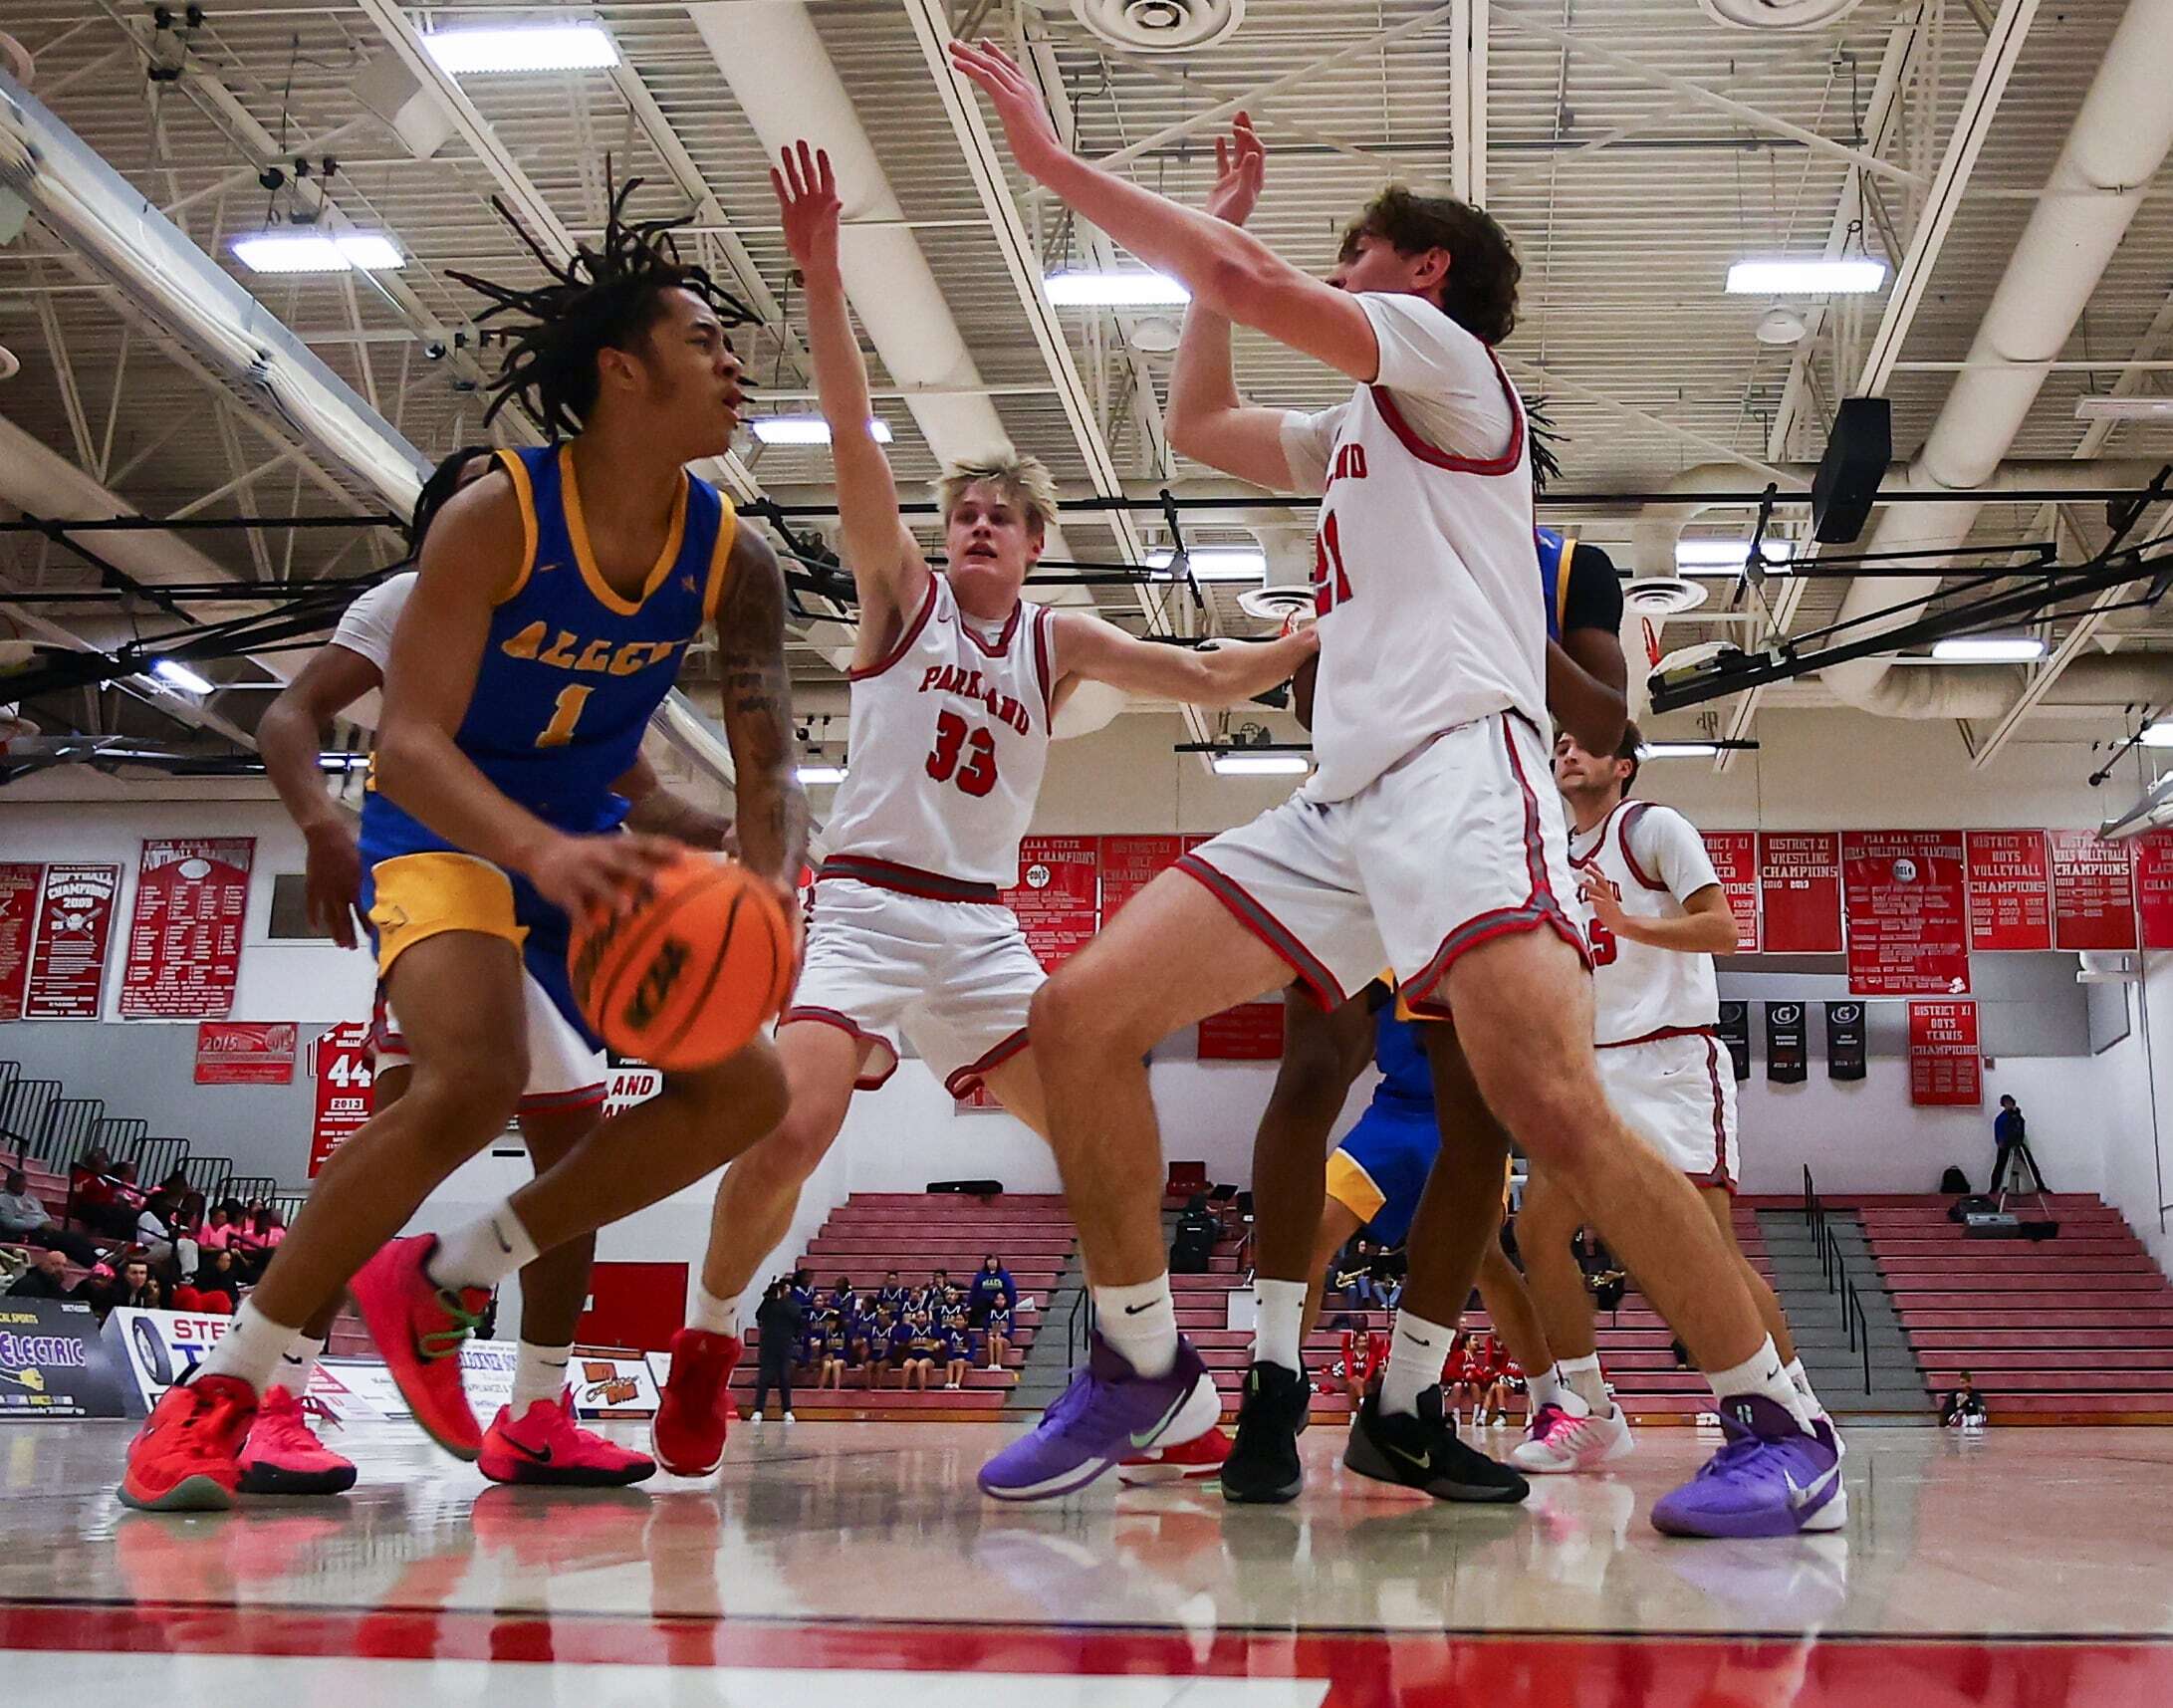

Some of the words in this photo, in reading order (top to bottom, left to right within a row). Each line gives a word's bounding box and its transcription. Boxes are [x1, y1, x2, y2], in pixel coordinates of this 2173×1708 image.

[535, 683, 596, 748] 1
[926, 709, 998, 797] 33
[1769, 839, 1814, 850] DISTRICT
[1770, 853, 1829, 864] WRESTLING
[1762, 865, 1838, 877] CHAMPIONS
[1973, 863, 2042, 876] VOLLEYBALL
[2053, 862, 2130, 876] CHAMPIONS
[1970, 880, 2047, 893] CHAMPIONS
[1914, 1005, 1955, 1016] DISTRICT
[328, 1054, 372, 1088] 44
[333, 1098, 362, 1108] 2013
[0, 1331, 86, 1367] ELECTRIC
